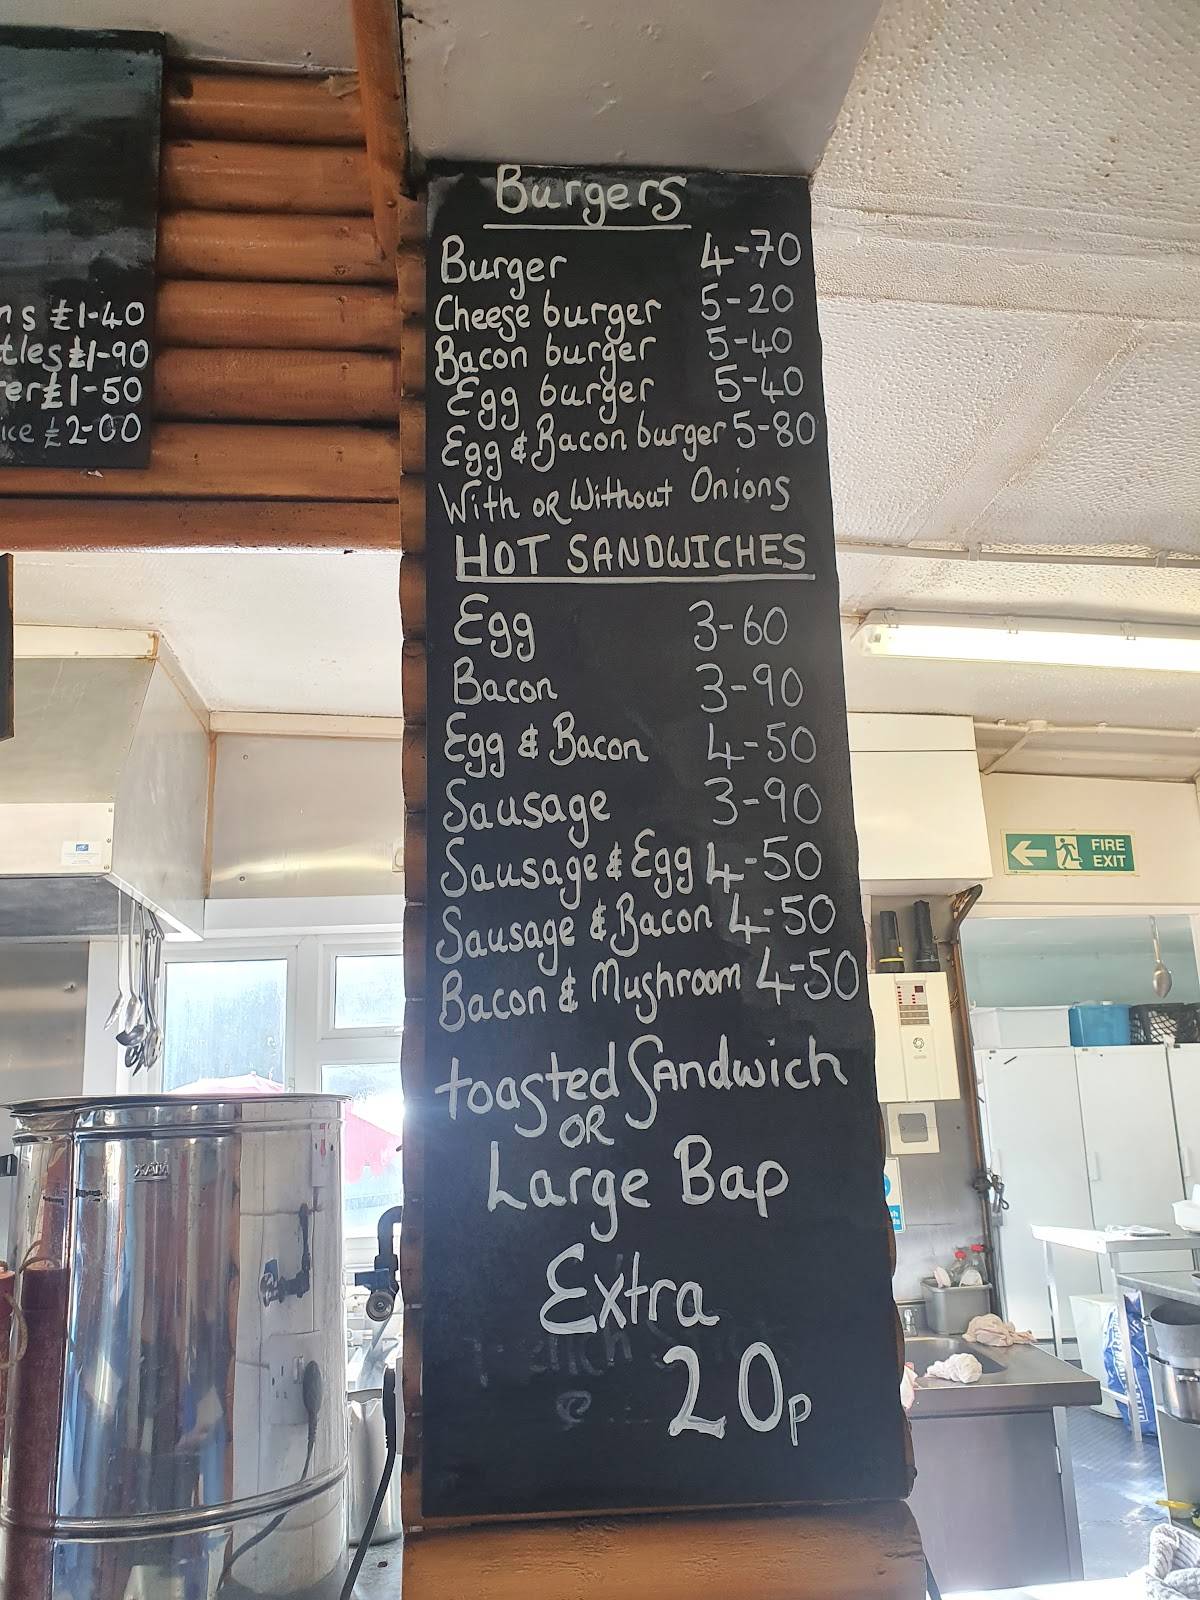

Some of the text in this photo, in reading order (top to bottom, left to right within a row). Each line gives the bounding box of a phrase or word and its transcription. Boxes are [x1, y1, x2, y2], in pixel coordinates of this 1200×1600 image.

[497, 164, 687, 226] Burgers
[440, 230, 801, 299] Burger 4-70
[435, 282, 794, 343] Cheese burger 5-20
[0, 333, 63, 372] tles
[435, 326, 792, 385] Bacon burger 5-40
[448, 365, 803, 430] Egg burger 5-40
[441, 409, 816, 481] Egg & Bacon burger 5-80
[438, 481, 520, 524] With
[570, 477, 672, 511] Without
[691, 466, 790, 511] Onions
[456, 533, 806, 576] HOT SANDWICHES
[454, 594, 788, 662] Egg 3-60
[453, 656, 803, 713] Bacon 3-90
[444, 711, 816, 778] Egg & Bacon 4-50
[442, 777, 822, 848] Sausage 3-90
[1091, 838, 1125, 851] FIRE
[440, 828, 822, 909] Sausage & Egg 4-50
[1093, 855, 1126, 867] EXIT
[436, 892, 836, 976] Sausage & Bacon 4-50
[439, 948, 860, 1032] Bacon & Mushroom 4-50
[434, 1041, 620, 1138] toasted
[487, 1134, 790, 1242] Large Bap
[539, 1243, 720, 1334] Extra
